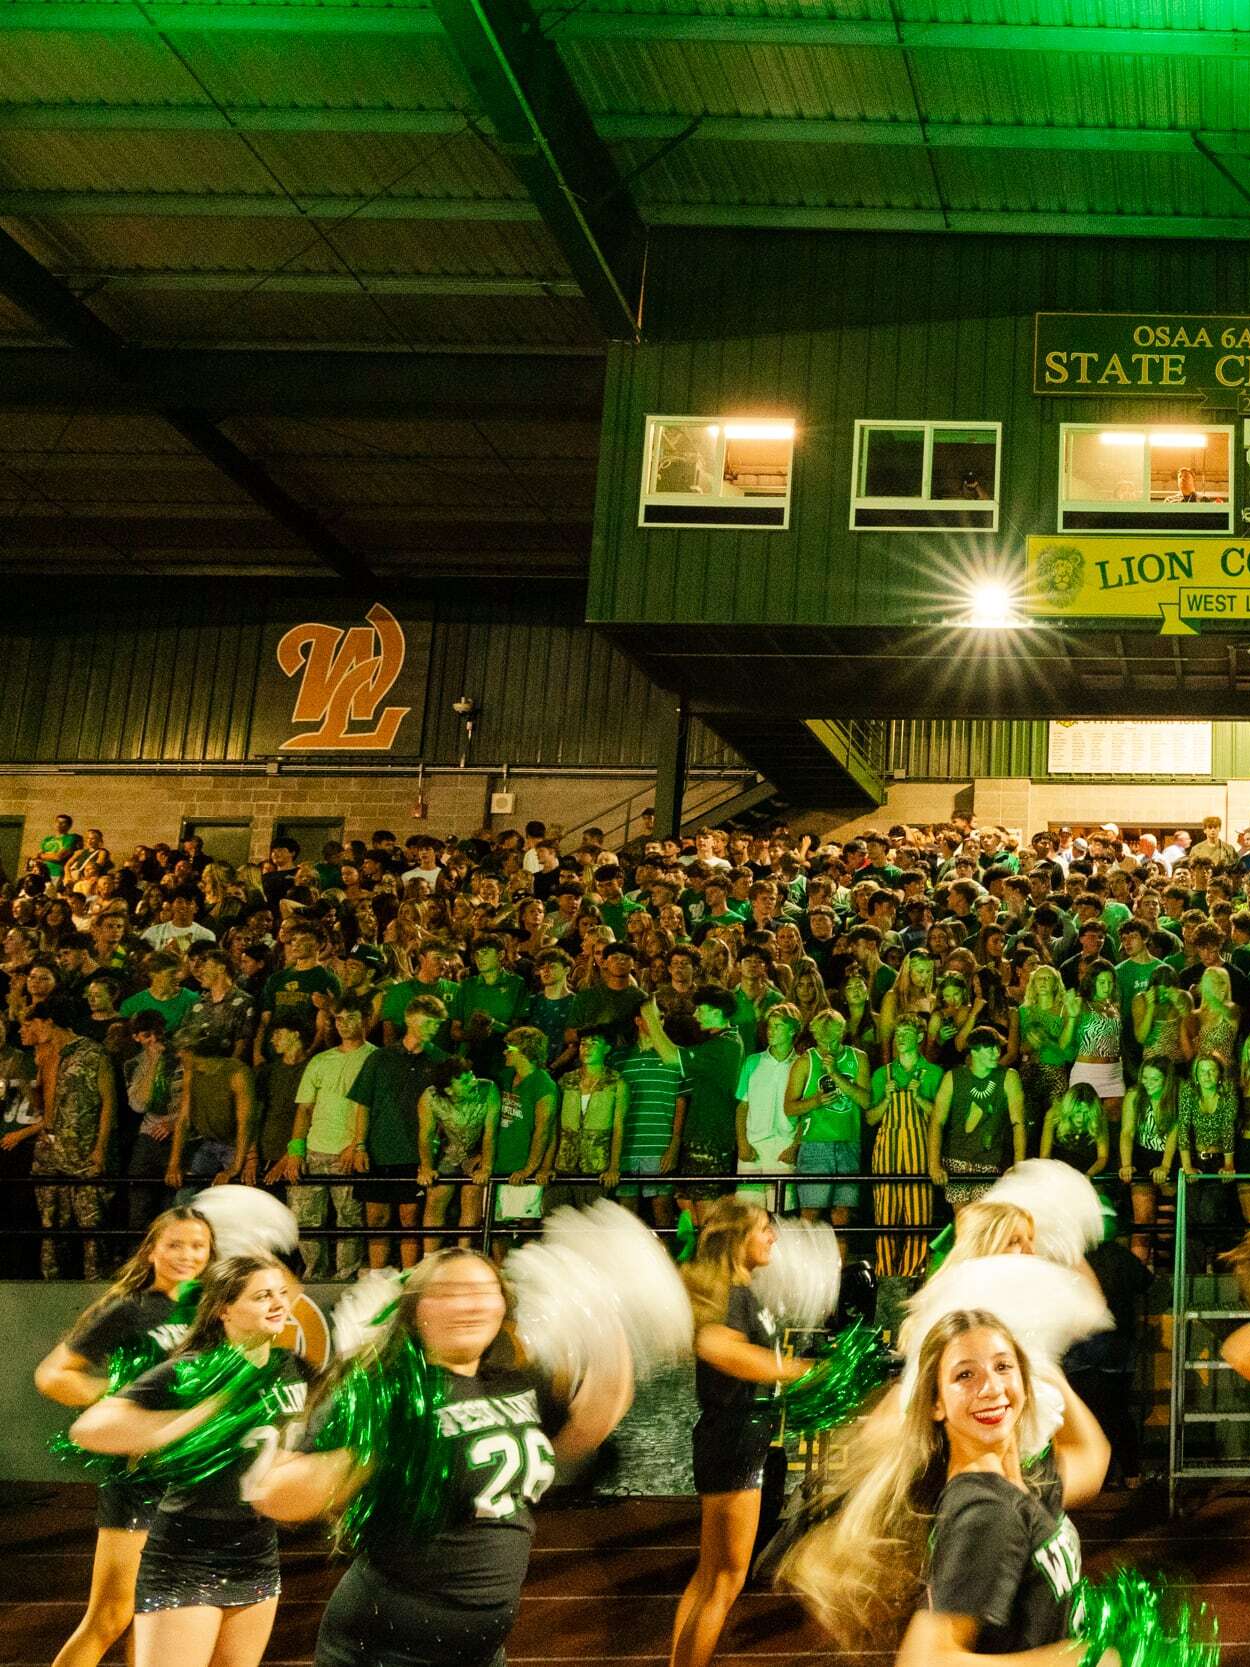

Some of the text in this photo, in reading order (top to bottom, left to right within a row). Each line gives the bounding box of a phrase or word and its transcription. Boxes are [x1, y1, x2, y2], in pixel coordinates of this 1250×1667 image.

[1133, 325, 1214, 348] OSAA
[1045, 351, 1187, 385] STATE
[1095, 550, 1195, 590] LION
[1186, 593, 1237, 612] WEST
[470, 1426, 557, 1518] 26
